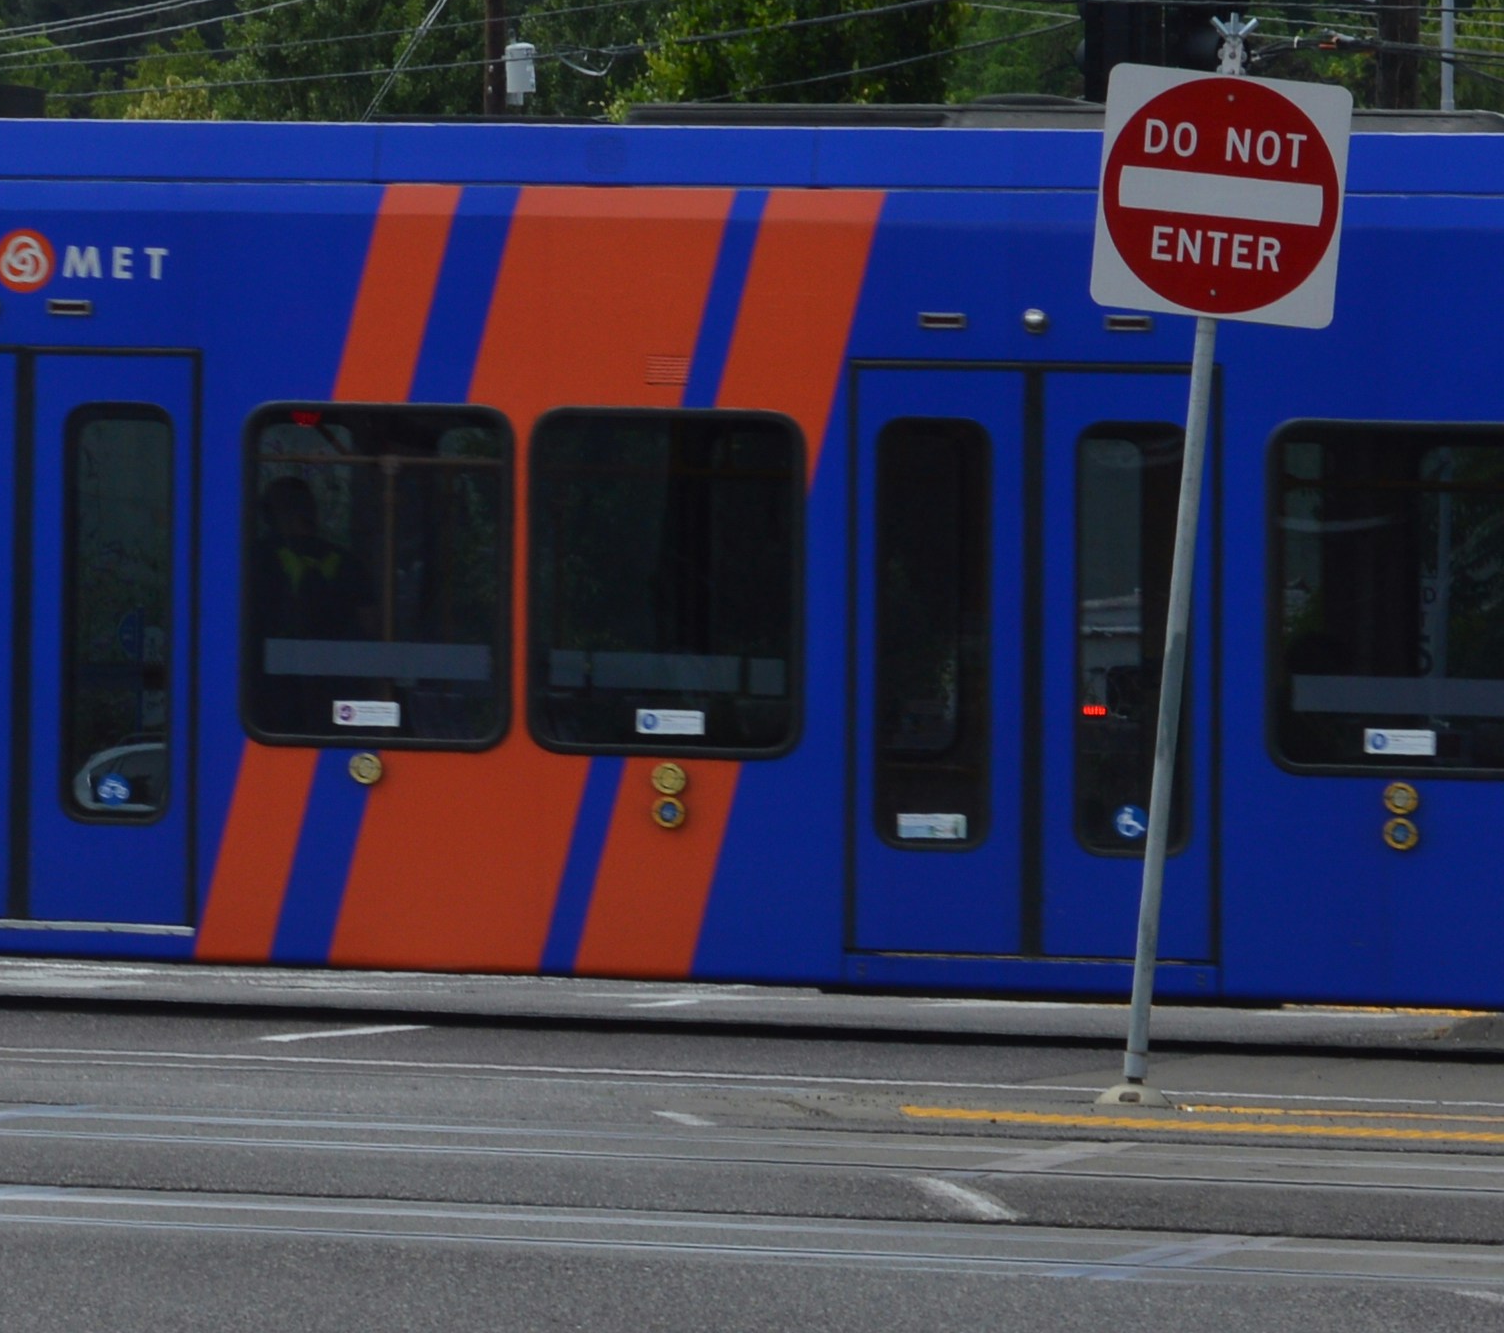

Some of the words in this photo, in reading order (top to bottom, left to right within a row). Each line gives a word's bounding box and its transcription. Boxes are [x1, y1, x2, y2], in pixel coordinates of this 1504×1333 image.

[1143, 118, 1198, 158] DO
[1224, 126, 1308, 169] NOT
[1150, 225, 1282, 273] ENTER
